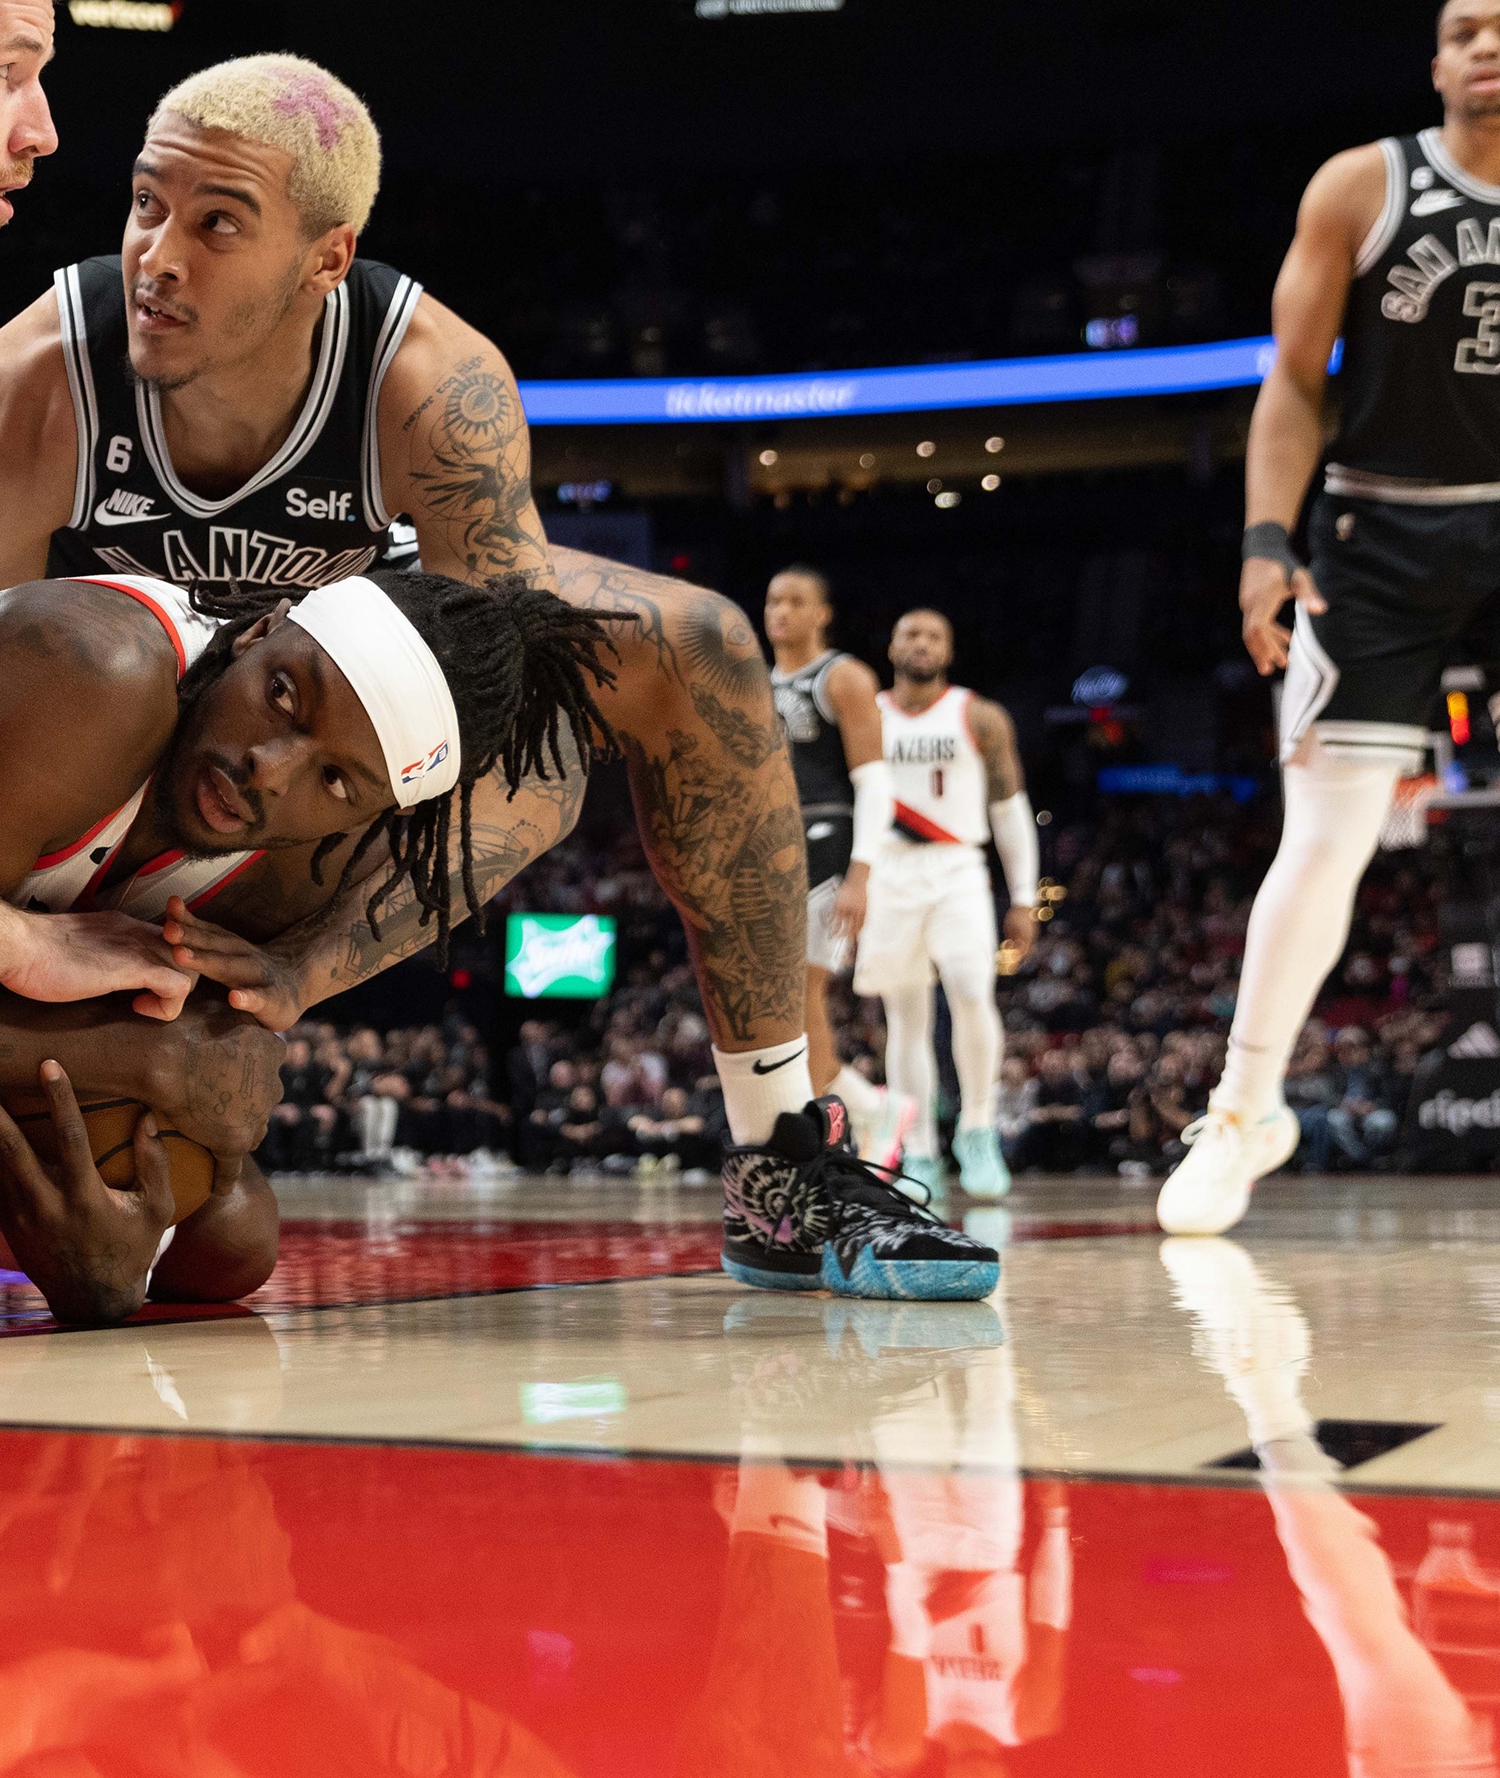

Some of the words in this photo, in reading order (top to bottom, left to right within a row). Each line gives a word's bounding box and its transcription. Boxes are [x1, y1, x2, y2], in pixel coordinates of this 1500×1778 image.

[1381, 233, 1459, 323] SAN
[106, 435, 133, 474] 6
[107, 488, 155, 517] NIKE
[285, 488, 356, 522] Self.
